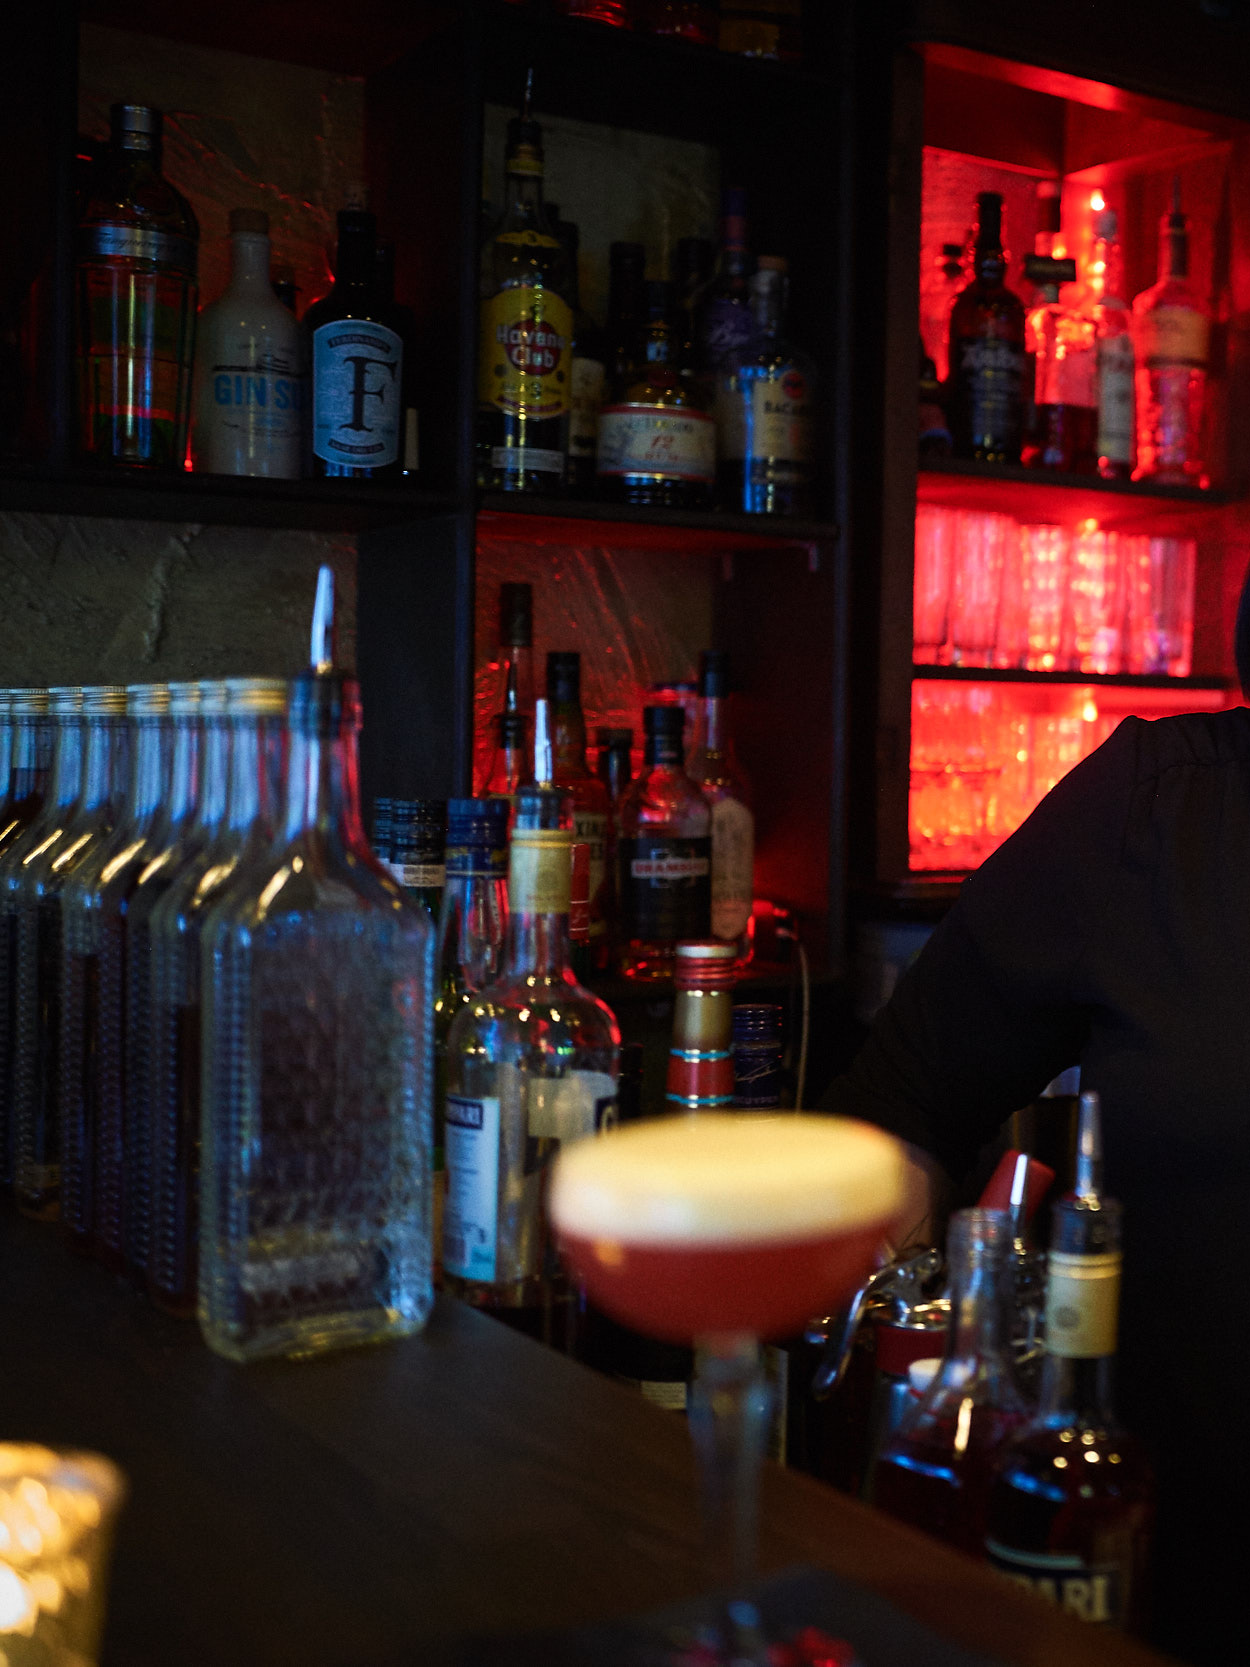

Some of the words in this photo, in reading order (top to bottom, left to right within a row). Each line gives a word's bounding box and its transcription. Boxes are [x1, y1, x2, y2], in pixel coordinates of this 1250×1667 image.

[496, 324, 566, 348] Havana
[511, 346, 556, 368] Club
[214, 374, 267, 407] GIN
[338, 356, 398, 432] F
